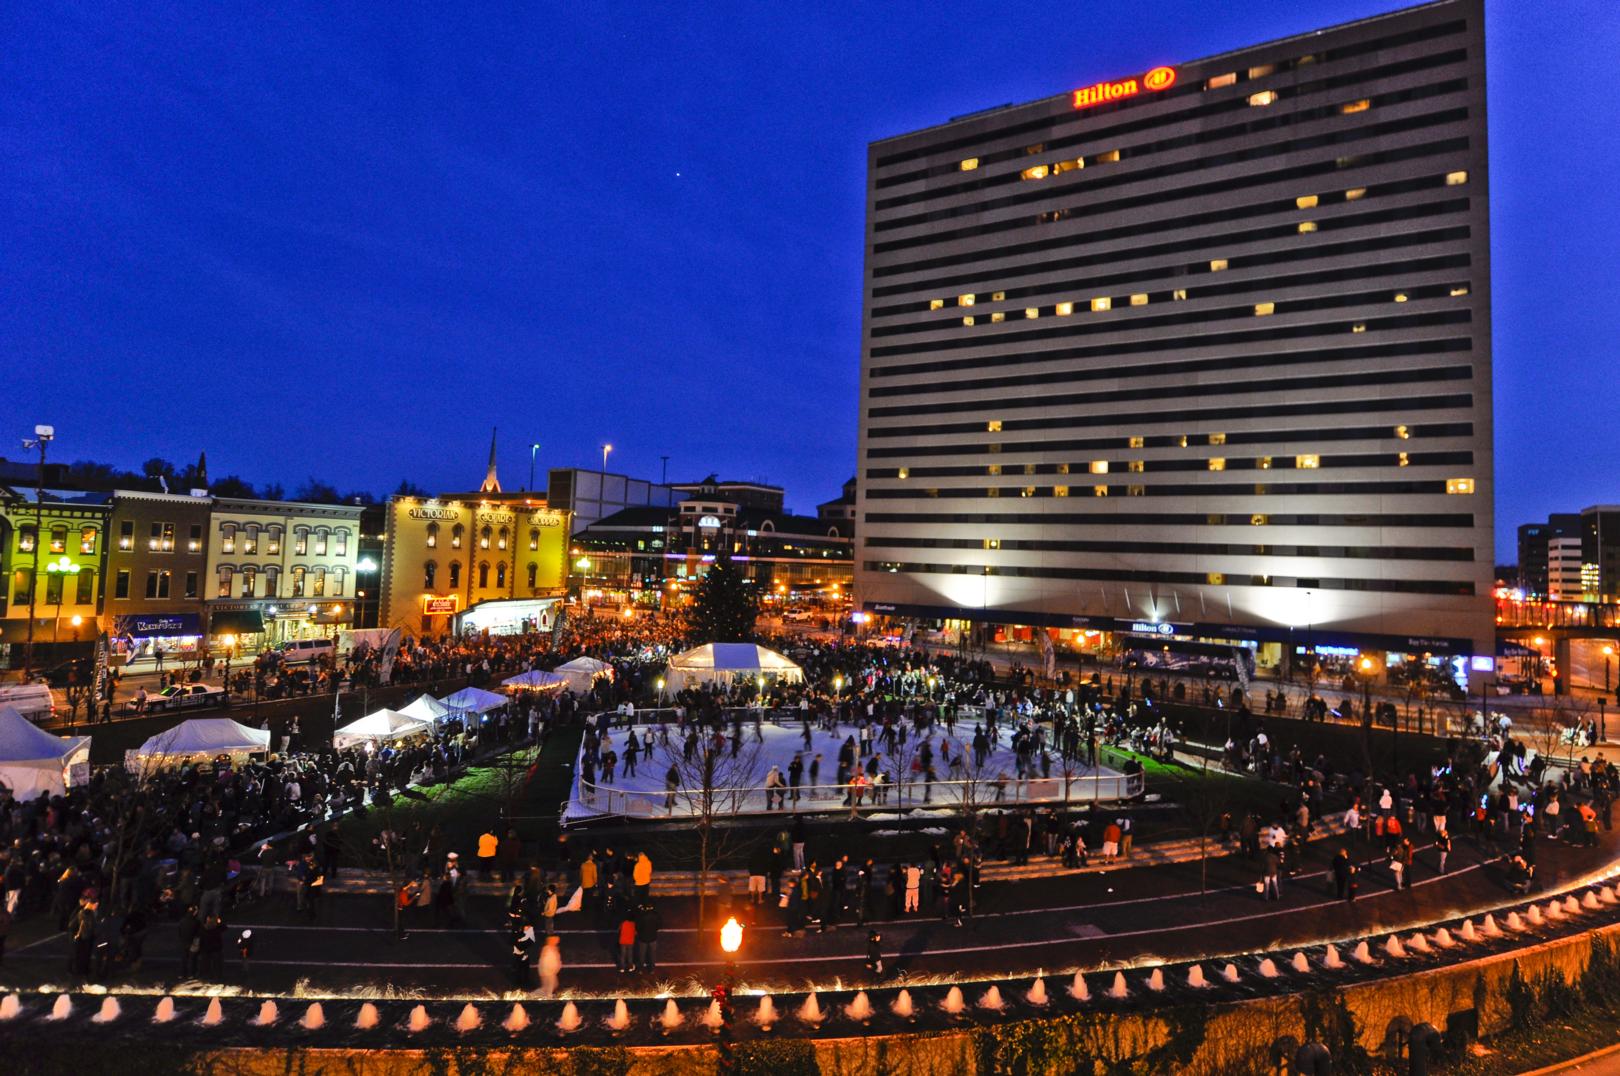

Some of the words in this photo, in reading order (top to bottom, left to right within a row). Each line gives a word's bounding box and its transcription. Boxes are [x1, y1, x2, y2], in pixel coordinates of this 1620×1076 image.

[1073, 80, 1138, 109] Hilton
[412, 508, 455, 519] VICTORIAN
[1132, 623, 1158, 633] Hilton
